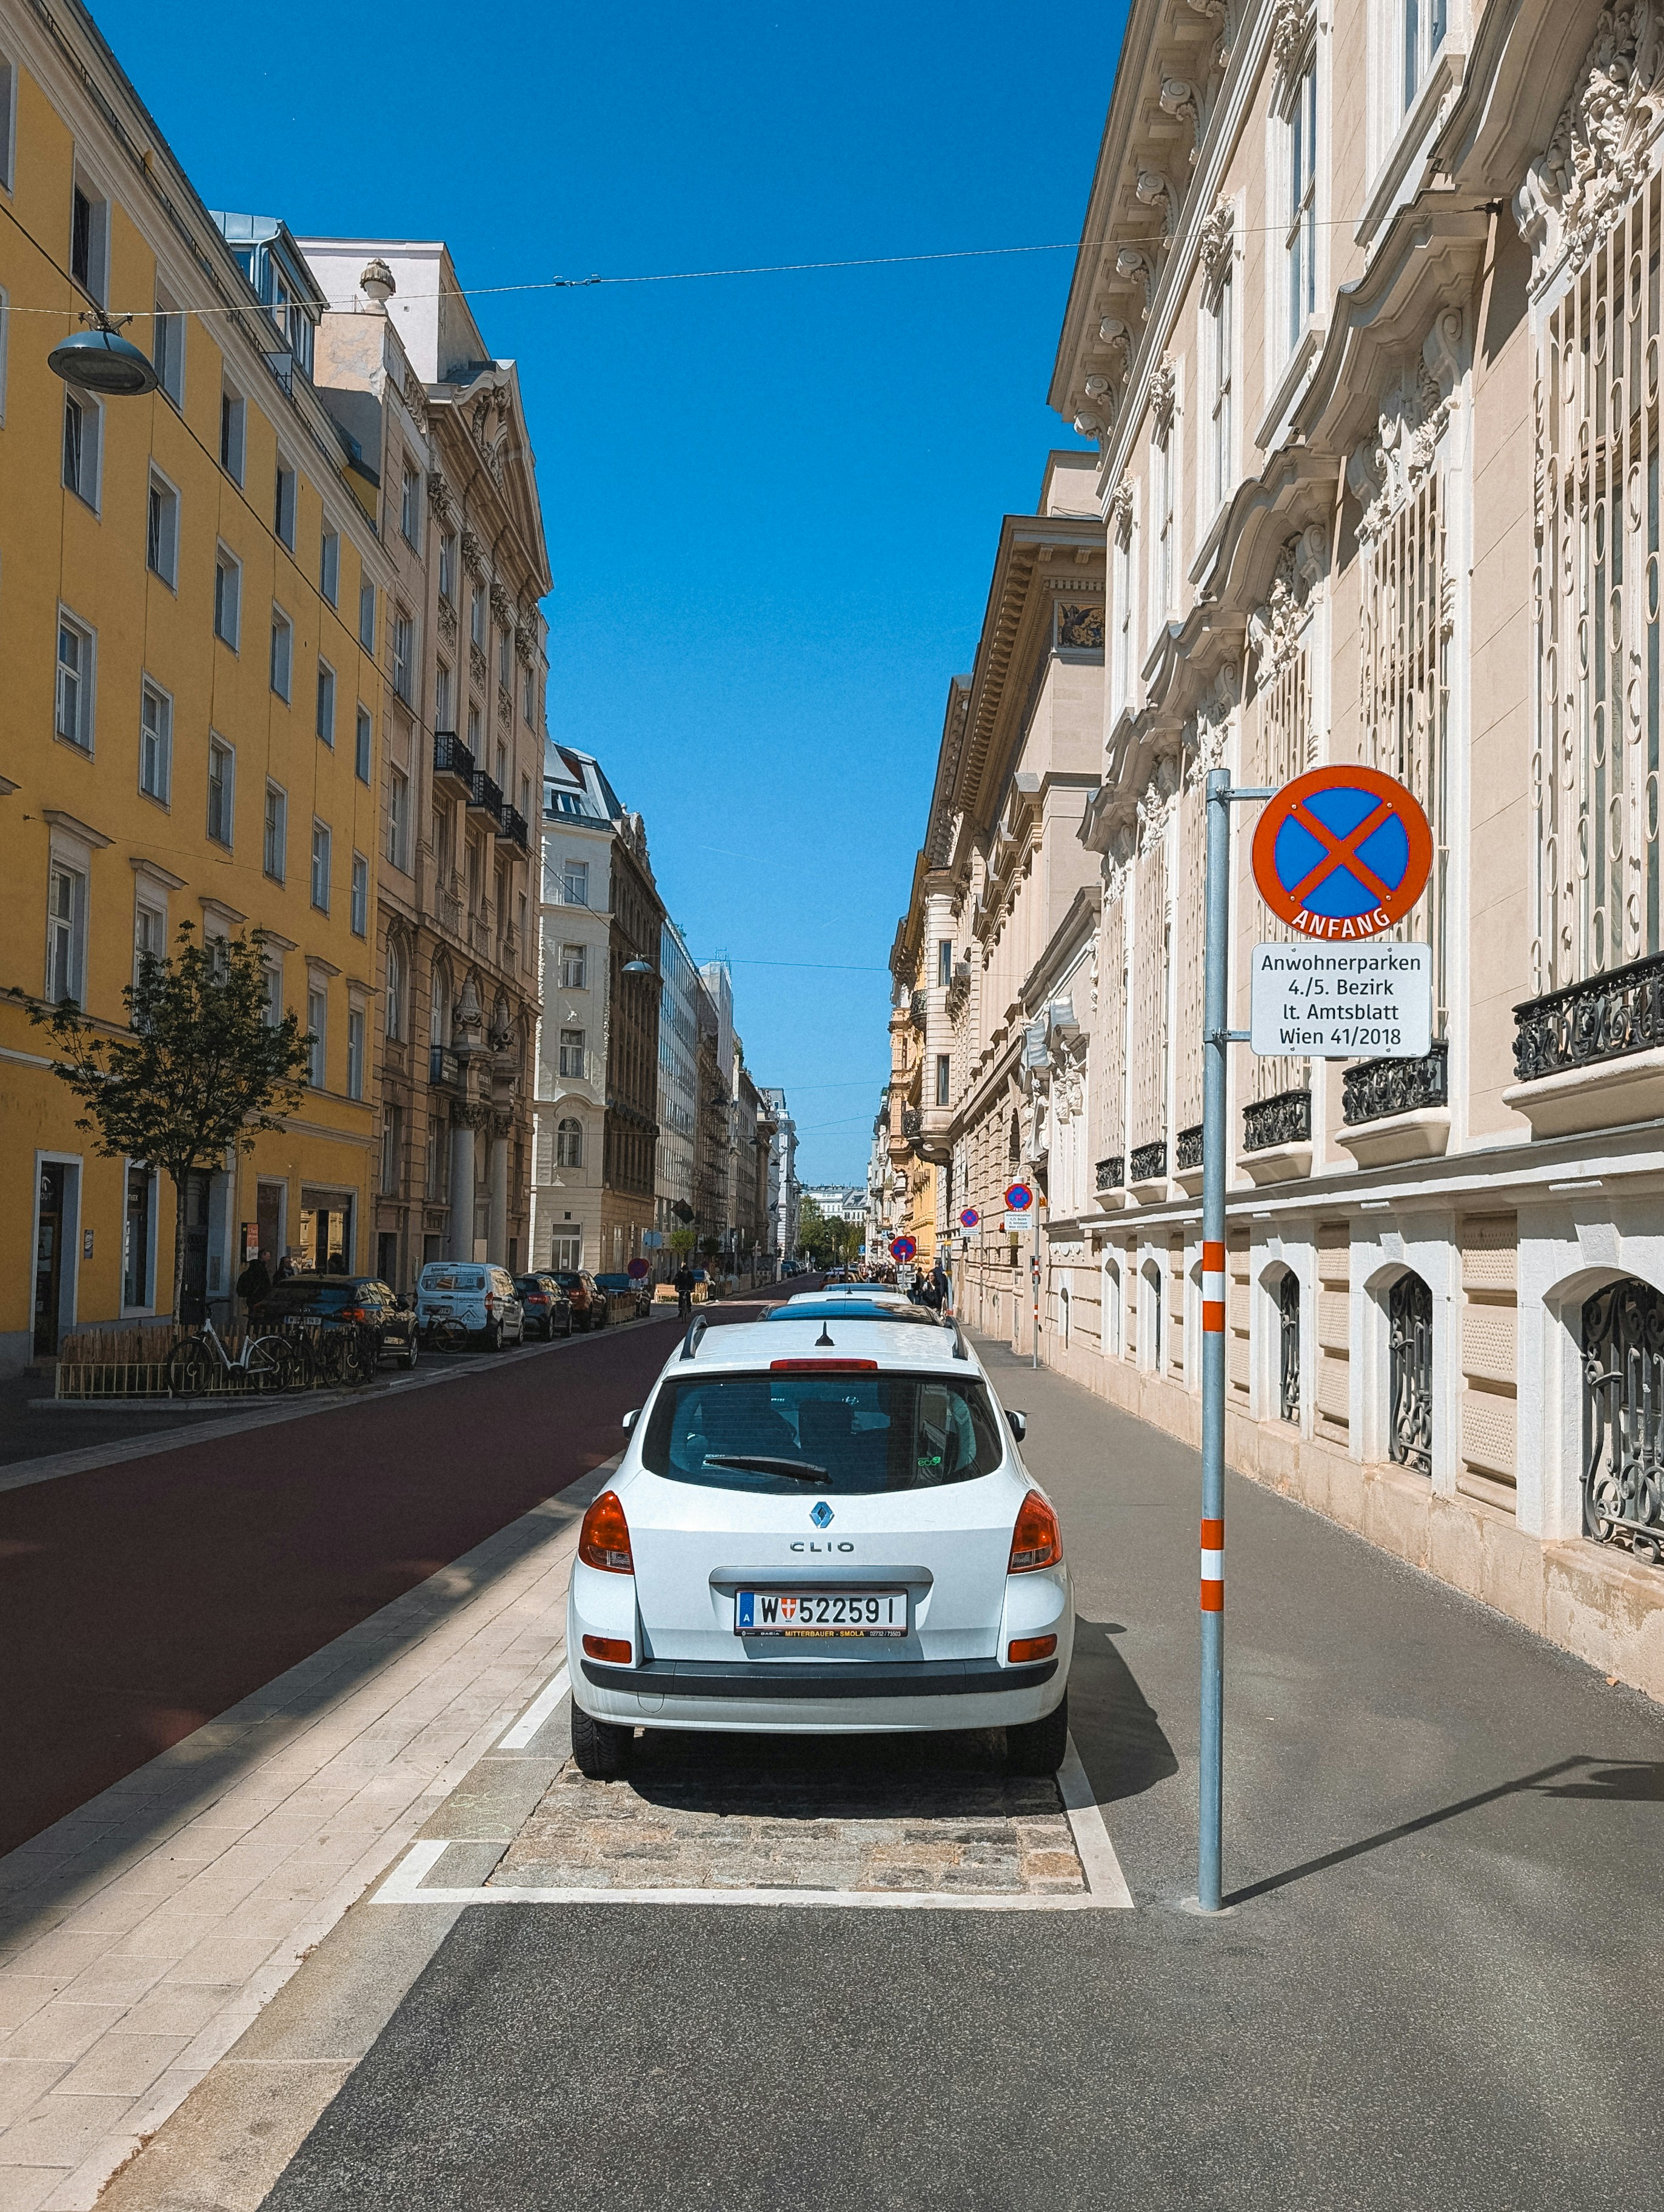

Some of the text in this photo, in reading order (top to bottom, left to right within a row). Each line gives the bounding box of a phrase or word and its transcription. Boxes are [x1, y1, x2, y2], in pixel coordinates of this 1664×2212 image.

[1292, 908, 1391, 938] ANFANG
[1261, 954, 1421, 974] Anwohnerparken
[1288, 977, 1394, 997] 4./5. Bezirk
[1284, 1003, 1399, 1020] lt. Amtsblatt
[1280, 1026, 1402, 1046] Wien 41/2018
[790, 1541, 855, 1552] CLIO
[743, 1614, 750, 1622] A
[761, 1597, 779, 1623] W
